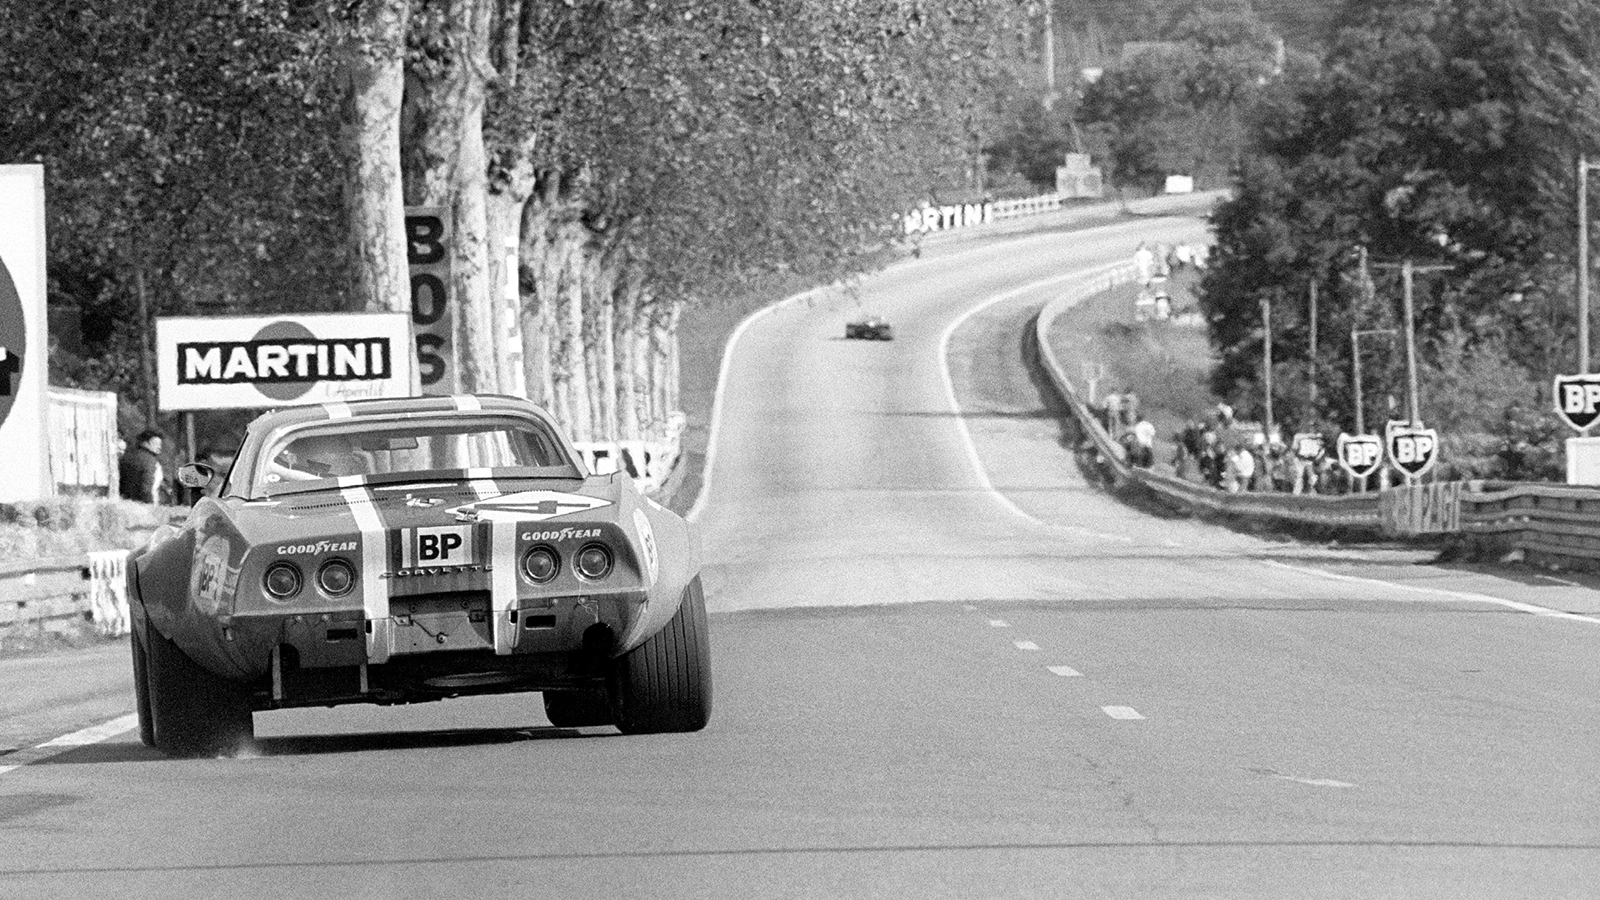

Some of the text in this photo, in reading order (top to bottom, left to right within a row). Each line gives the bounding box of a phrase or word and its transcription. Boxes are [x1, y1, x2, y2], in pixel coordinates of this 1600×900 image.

[185, 343, 383, 379] MARTINI
[1564, 384, 1600, 413] BP
[1349, 443, 1378, 466] BP
[1398, 437, 1433, 463] BP
[419, 533, 462, 560] BP
[521, 527, 601, 542] GOODYEAR
[277, 540, 357, 555] GOODYEAR
[379, 565, 493, 579] CORVETTE
